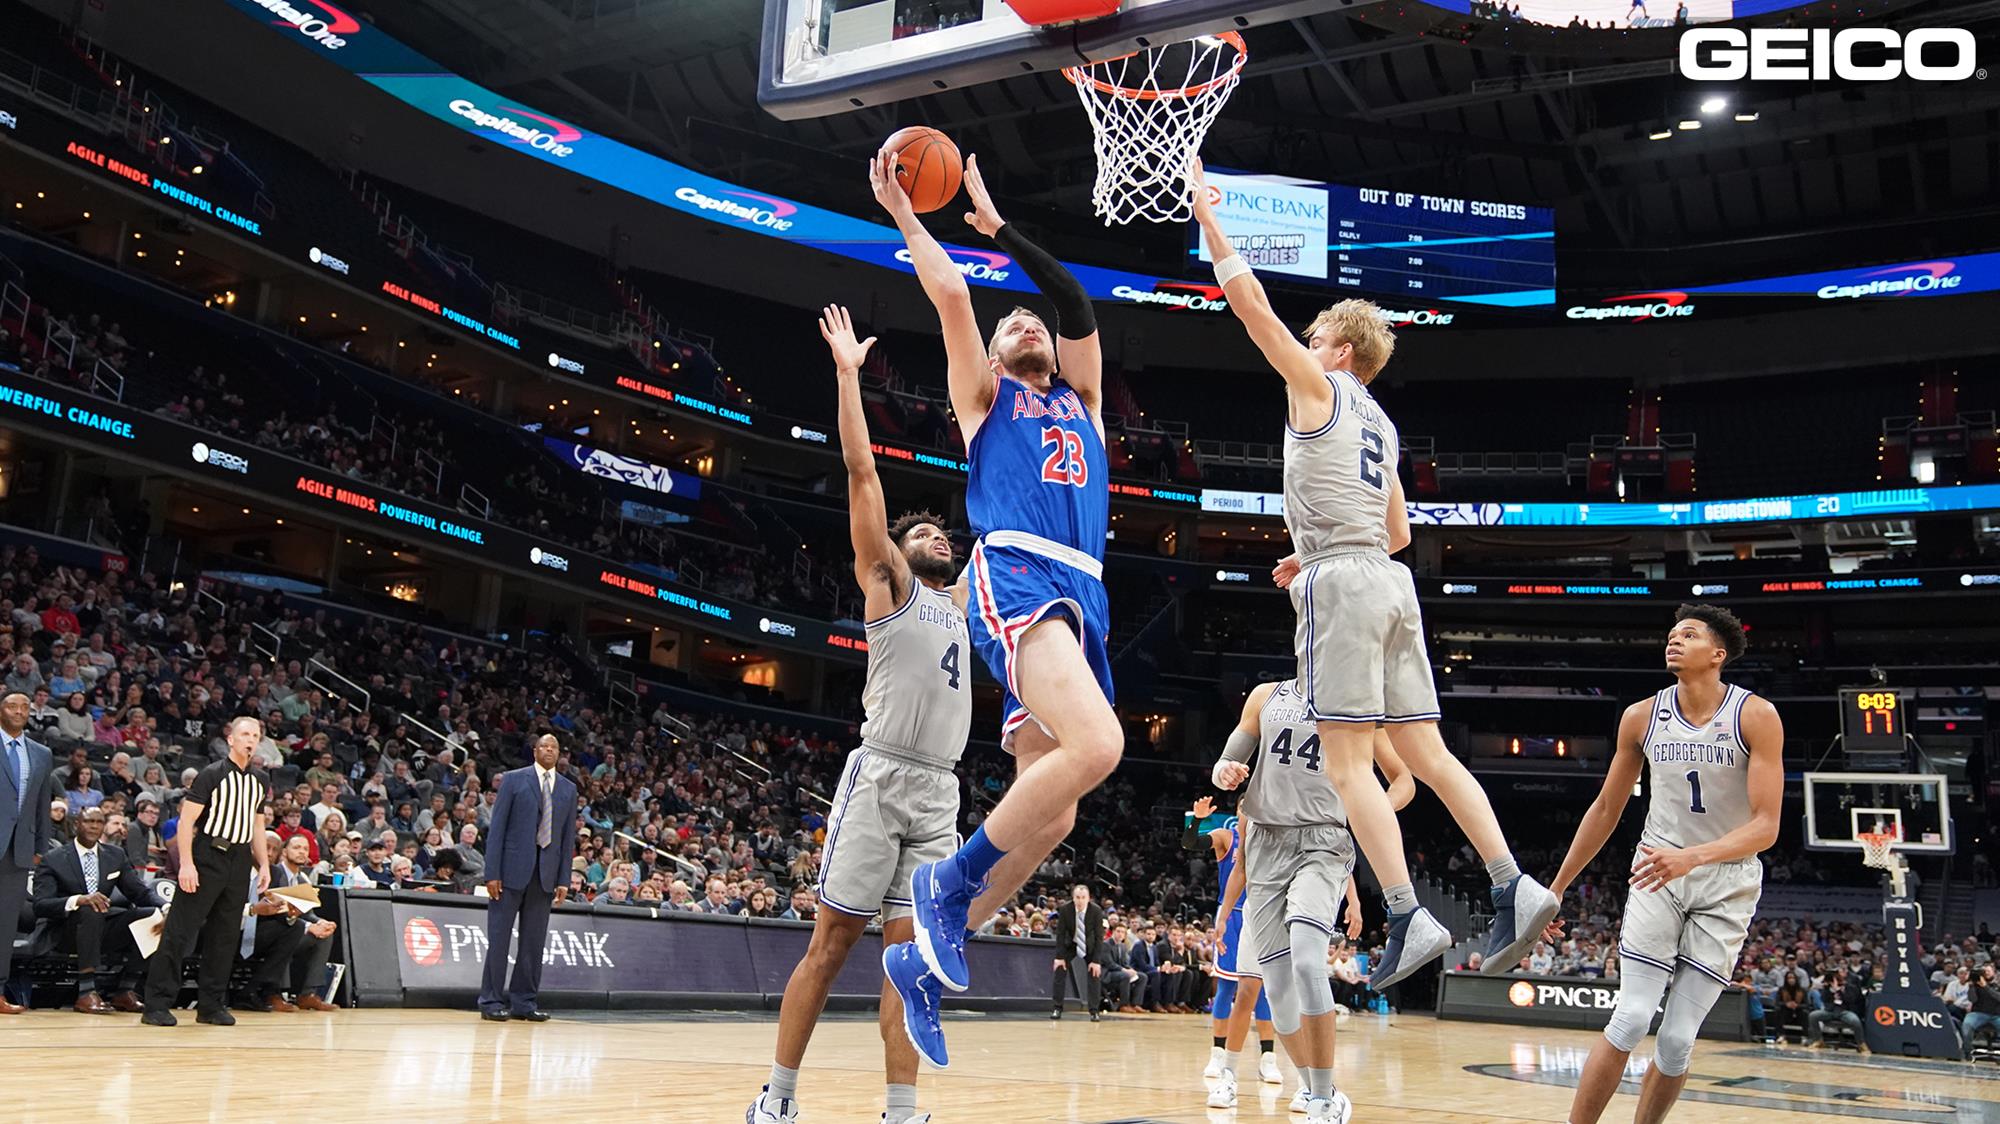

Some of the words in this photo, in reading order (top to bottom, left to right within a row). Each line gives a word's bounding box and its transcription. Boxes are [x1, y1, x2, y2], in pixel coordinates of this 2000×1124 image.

[66, 141, 104, 167] AGILE
[107, 159, 151, 187] MINDS.
[153, 179, 213, 214] POWERFUL
[216, 206, 262, 236] CHANGE.
[1226, 191, 1268, 212] PNC
[1272, 198, 1325, 220] BANK
[1359, 188, 1390, 205] OUT
[1395, 192, 1414, 208] OF
[1420, 195, 1465, 214] TOWN
[1471, 201, 1526, 220] SCORES
[1250, 234, 1268, 249] OF
[1268, 234, 1305, 249] TOWN
[382, 281, 409, 301] AGILE
[410, 293, 442, 315] MINDS.
[442, 307, 486, 335] POWERFUL
[486, 327, 521, 350] CHANGE.
[0, 385, 62, 418] WERFUL
[67, 407, 135, 439] CHANGE.
[616, 376, 643, 392] AGILE
[643, 384, 674, 401] MINDS.
[674, 393, 717, 414] POWERFUL
[718, 407, 753, 425] CHANGE.
[915, 453, 958, 470] POWERFUL
[1041, 425, 1088, 488] 23
[1360, 426, 1384, 491] 2
[296, 476, 333, 500] AGILE
[335, 489, 378, 513] MINDS.
[379, 502, 437, 531] POWERFUL
[440, 521, 484, 545] CHANGE.
[1153, 490, 1197, 503] POWERFUL
[1212, 498, 1244, 508] PERIOD
[1256, 495, 1265, 513] 1
[1704, 499, 1792, 521] GEORGETOWN
[1816, 496, 1840, 514] 20
[600, 571, 626, 589] AGILE
[627, 580, 657, 598] MINDS.
[657, 588, 698, 610] POWERFUL
[700, 600, 732, 621] CHANGE.
[1508, 585, 1532, 593] AGILE
[1566, 586, 1611, 594] POWERFUL
[1613, 586, 1651, 594] CHANGE.
[1762, 582, 1789, 592] AGILE
[1826, 579, 1877, 589] POWERFUL
[1879, 577, 1923, 587] CHANGE.
[919, 603, 953, 630] GEORG
[827, 634, 852, 649] AGILE
[940, 641, 961, 691] 4
[1858, 693, 1896, 710] 8:03
[1865, 709, 1893, 734] 17
[1270, 727, 1321, 774] 44
[1653, 742, 1735, 767] GEORGETOWN
[1686, 770, 1706, 814] 1
[542, 930, 614, 967] ANK
[1895, 918, 1910, 988] HOYAS
[1537, 985, 1592, 1008] PNC
[1896, 1009, 1943, 1029] PNC
